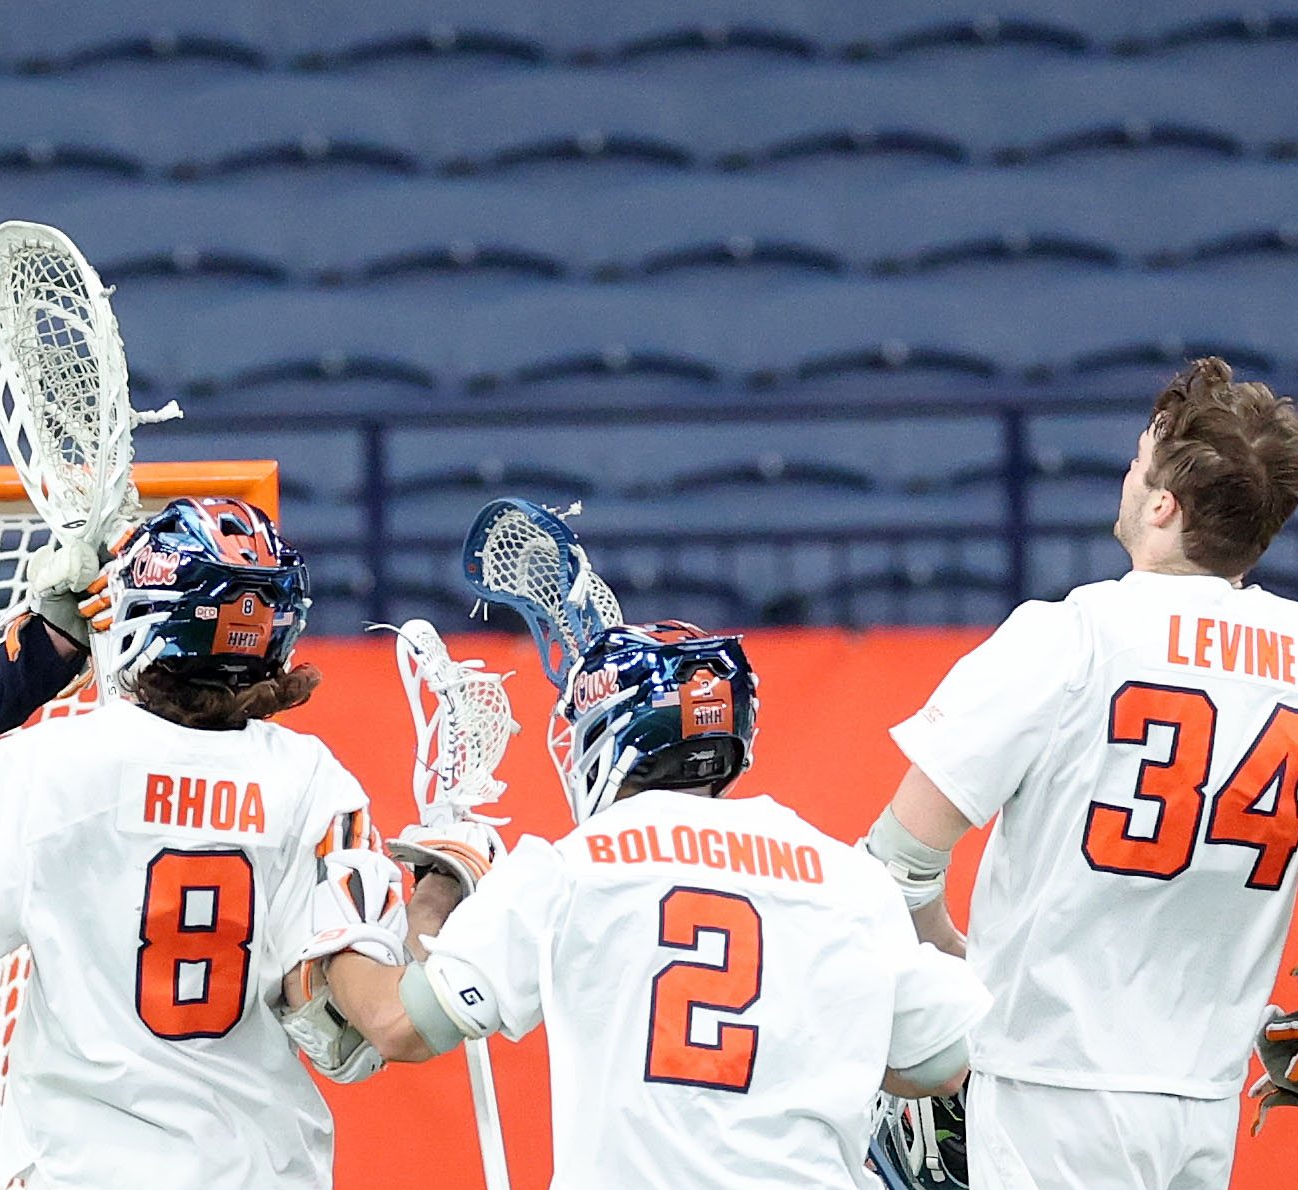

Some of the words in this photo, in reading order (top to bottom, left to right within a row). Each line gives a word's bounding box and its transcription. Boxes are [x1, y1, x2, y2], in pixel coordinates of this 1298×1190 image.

[242, 597, 255, 617] 8
[1167, 614, 1297, 685] LEVINE
[143, 772, 266, 834] RHOA
[584, 824, 825, 885] BOLOGNINO
[135, 848, 256, 1041] 8
[643, 884, 763, 1095] 2
